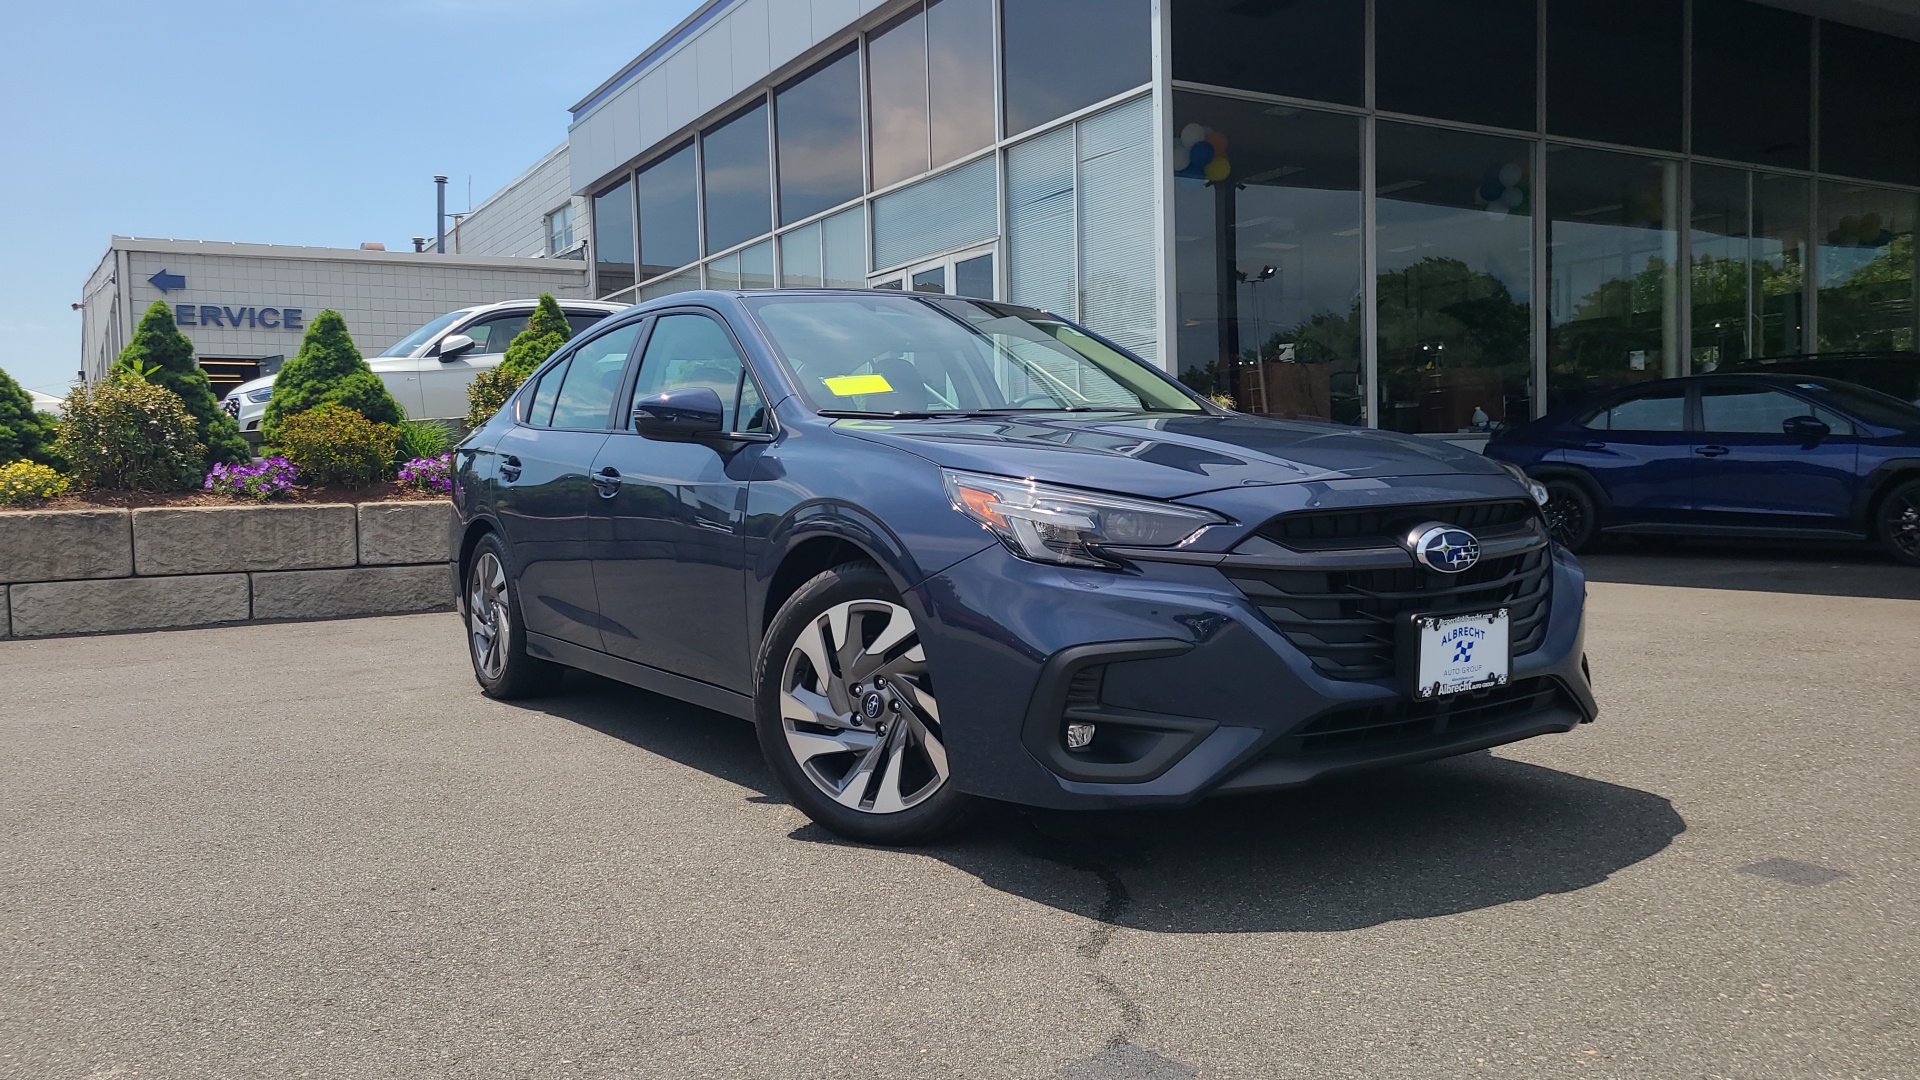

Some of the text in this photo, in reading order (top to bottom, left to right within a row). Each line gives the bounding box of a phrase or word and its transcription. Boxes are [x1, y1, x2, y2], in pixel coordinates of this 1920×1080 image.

[175, 304, 304, 330] ERVICE
[1441, 626, 1485, 646] ALBRECHT
[1443, 664, 1482, 676] AUTO GROUP
[1438, 680, 1472, 696] Albrecht
